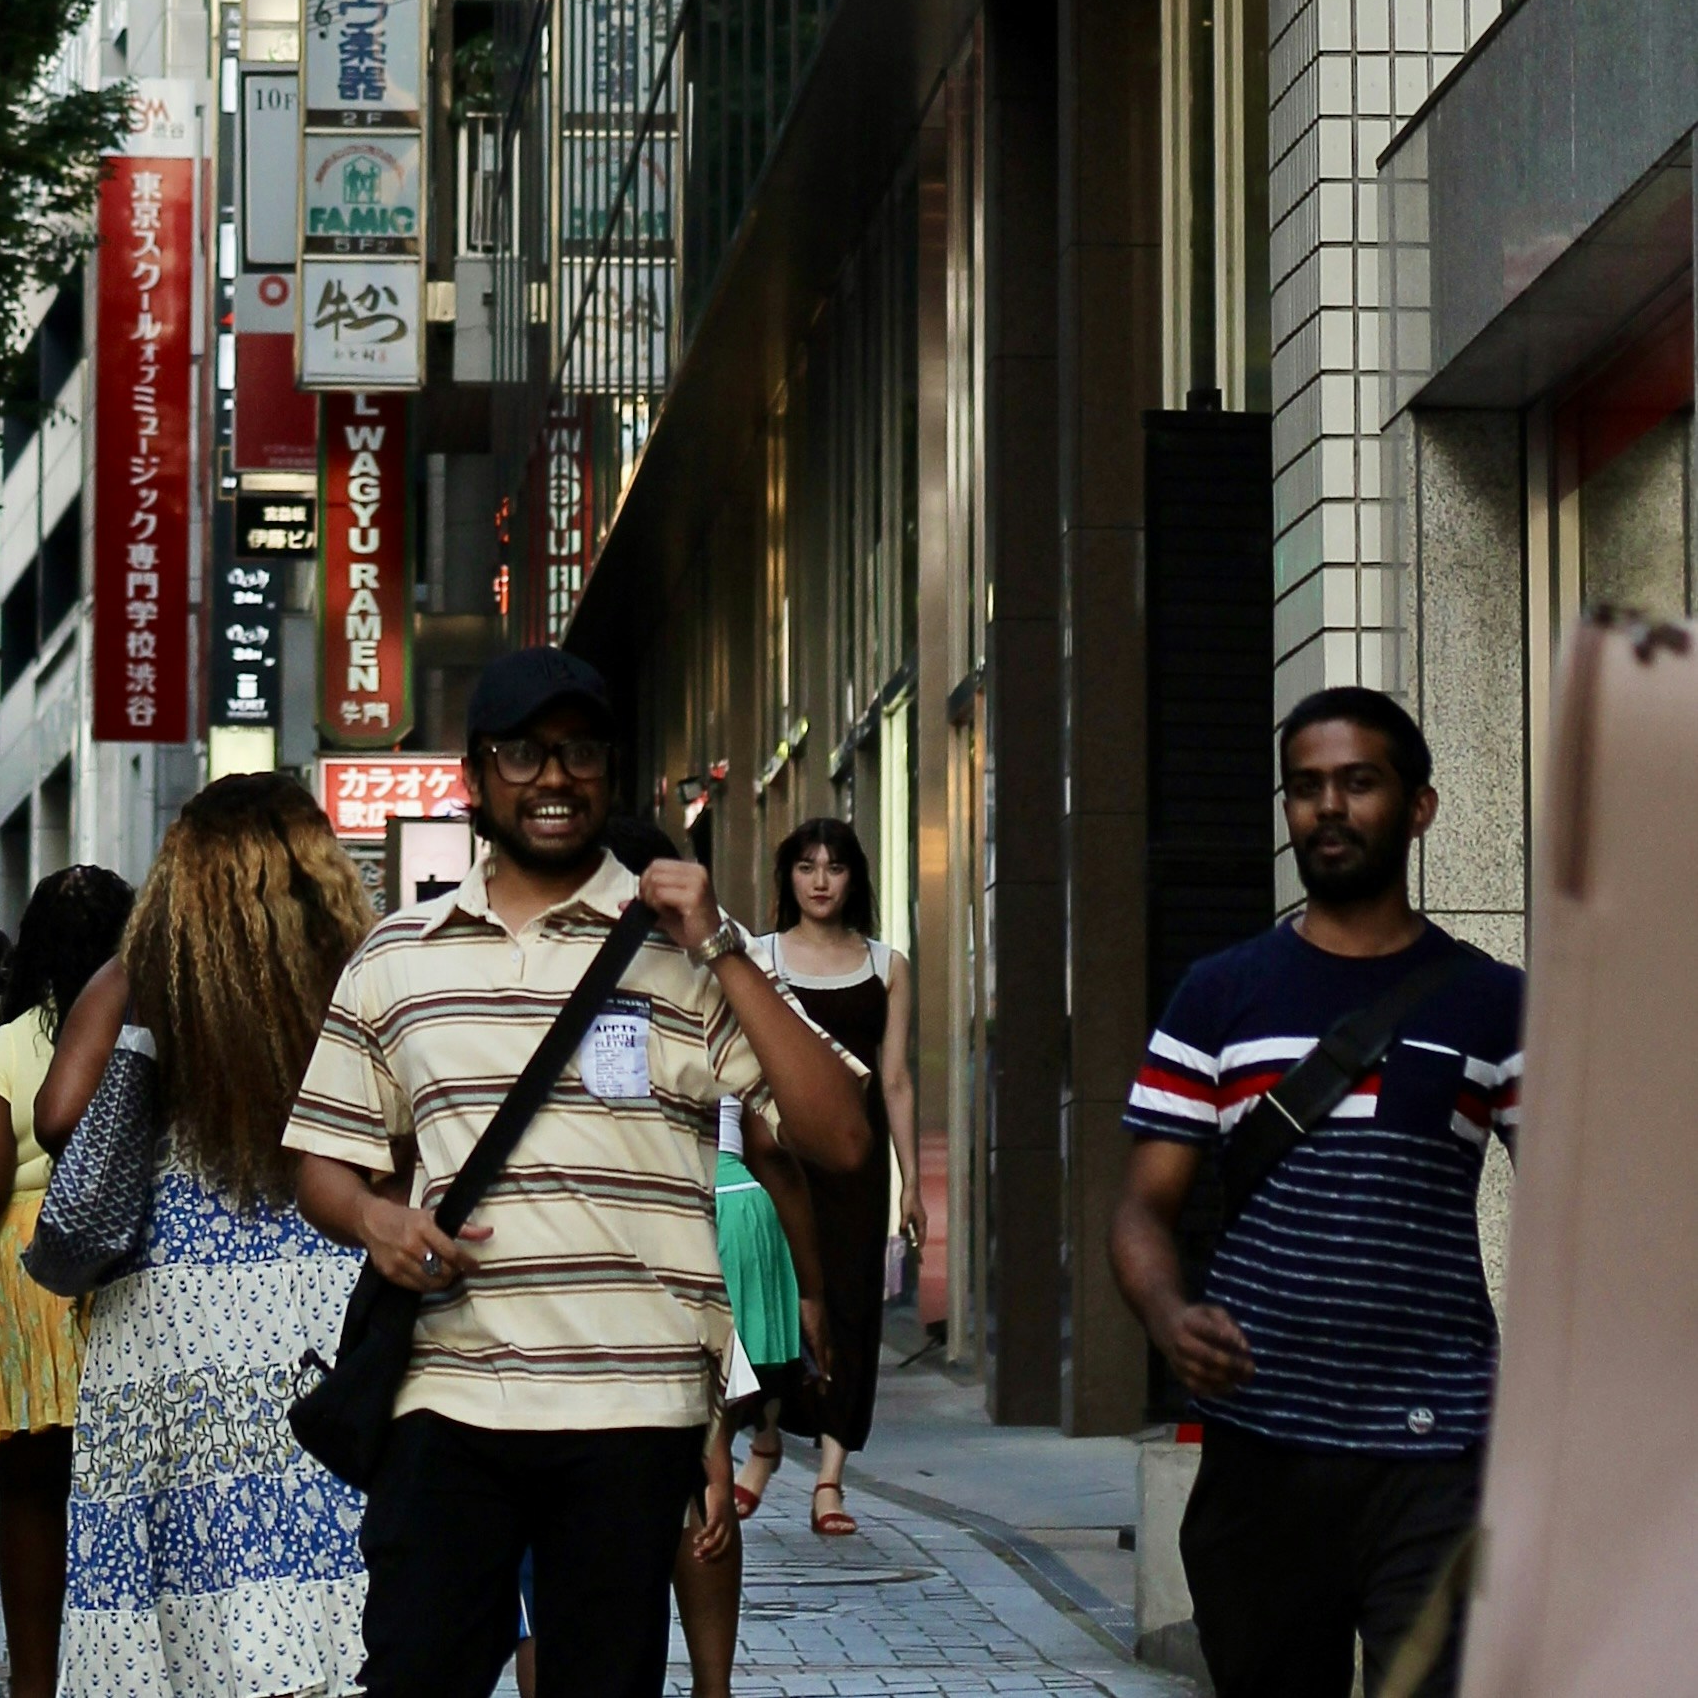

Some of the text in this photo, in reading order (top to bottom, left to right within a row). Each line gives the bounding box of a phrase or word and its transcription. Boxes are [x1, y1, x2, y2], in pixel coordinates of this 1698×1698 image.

[308, 206, 416, 234] FAMIC
[344, 425, 385, 693] WAGYU RAMEN
[337, 765, 457, 798] カラオケ
